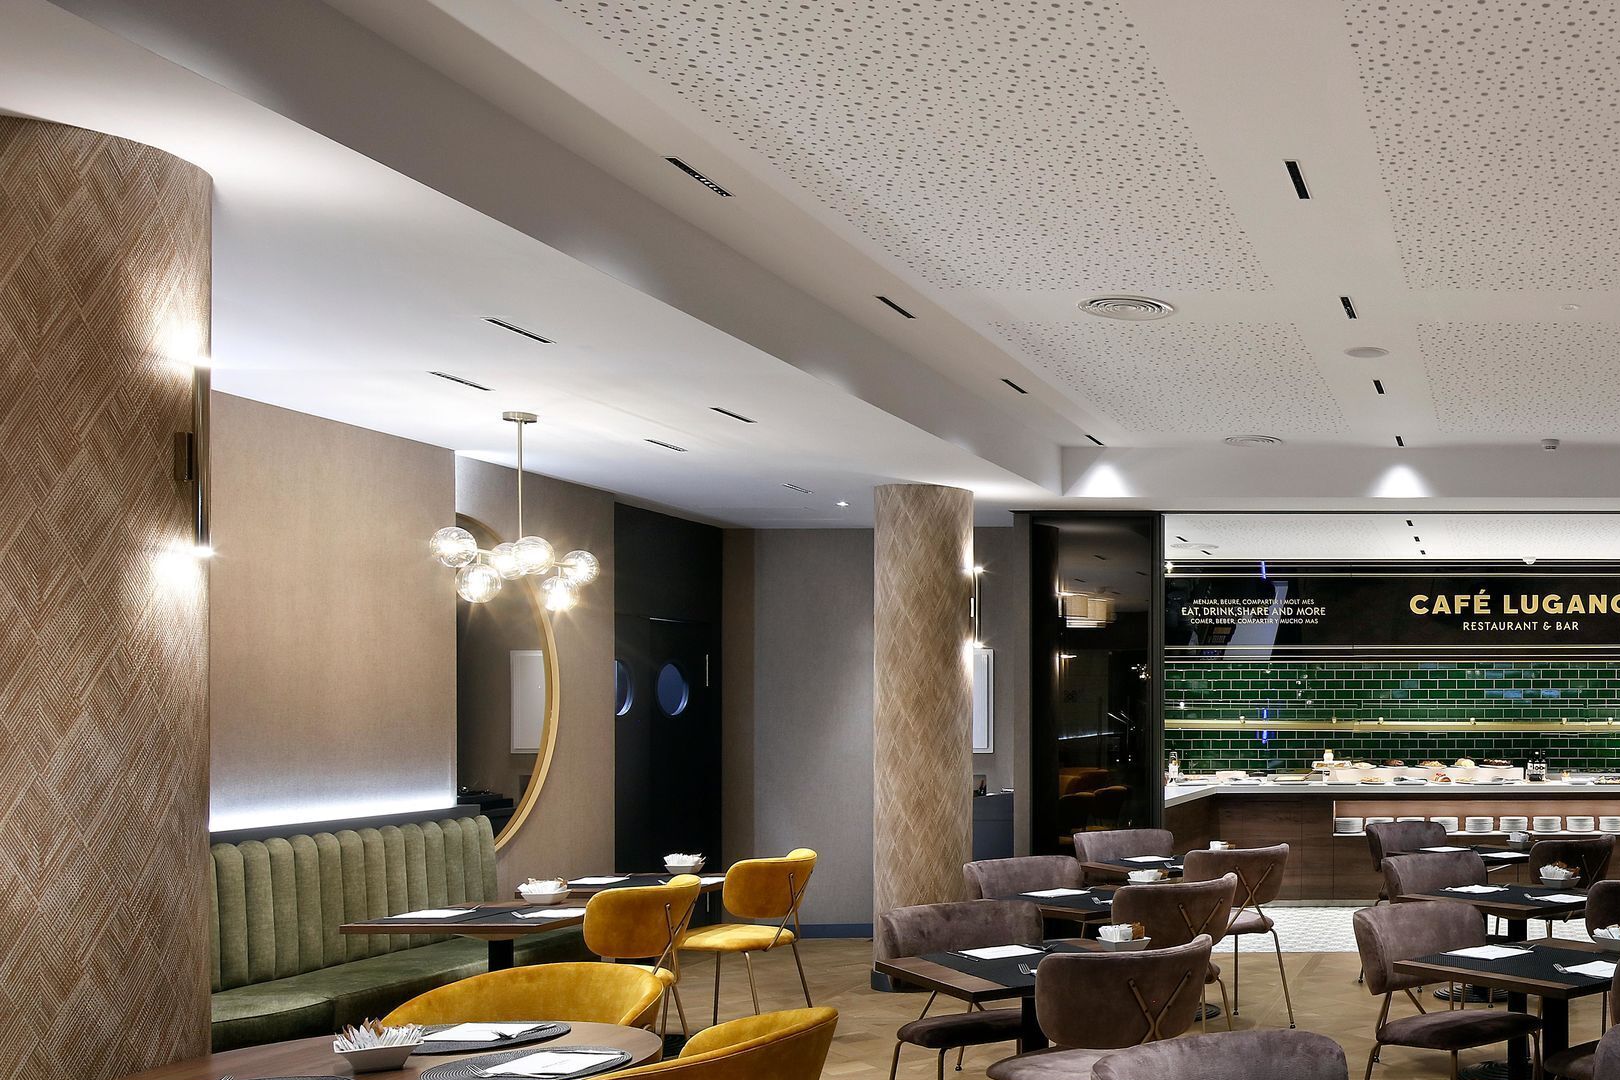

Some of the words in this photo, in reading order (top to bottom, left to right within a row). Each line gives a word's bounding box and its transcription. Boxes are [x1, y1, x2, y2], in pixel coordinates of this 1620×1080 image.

[1409, 588, 1491, 615] CAFÉ
[1181, 606, 1201, 617] EAT,
[1271, 606, 1294, 616] AND
[1296, 606, 1326, 616] MORE
[1462, 621, 1539, 631] RESTAURANT
[1543, 621, 1552, 631] &
[1555, 621, 1580, 631] BAR
